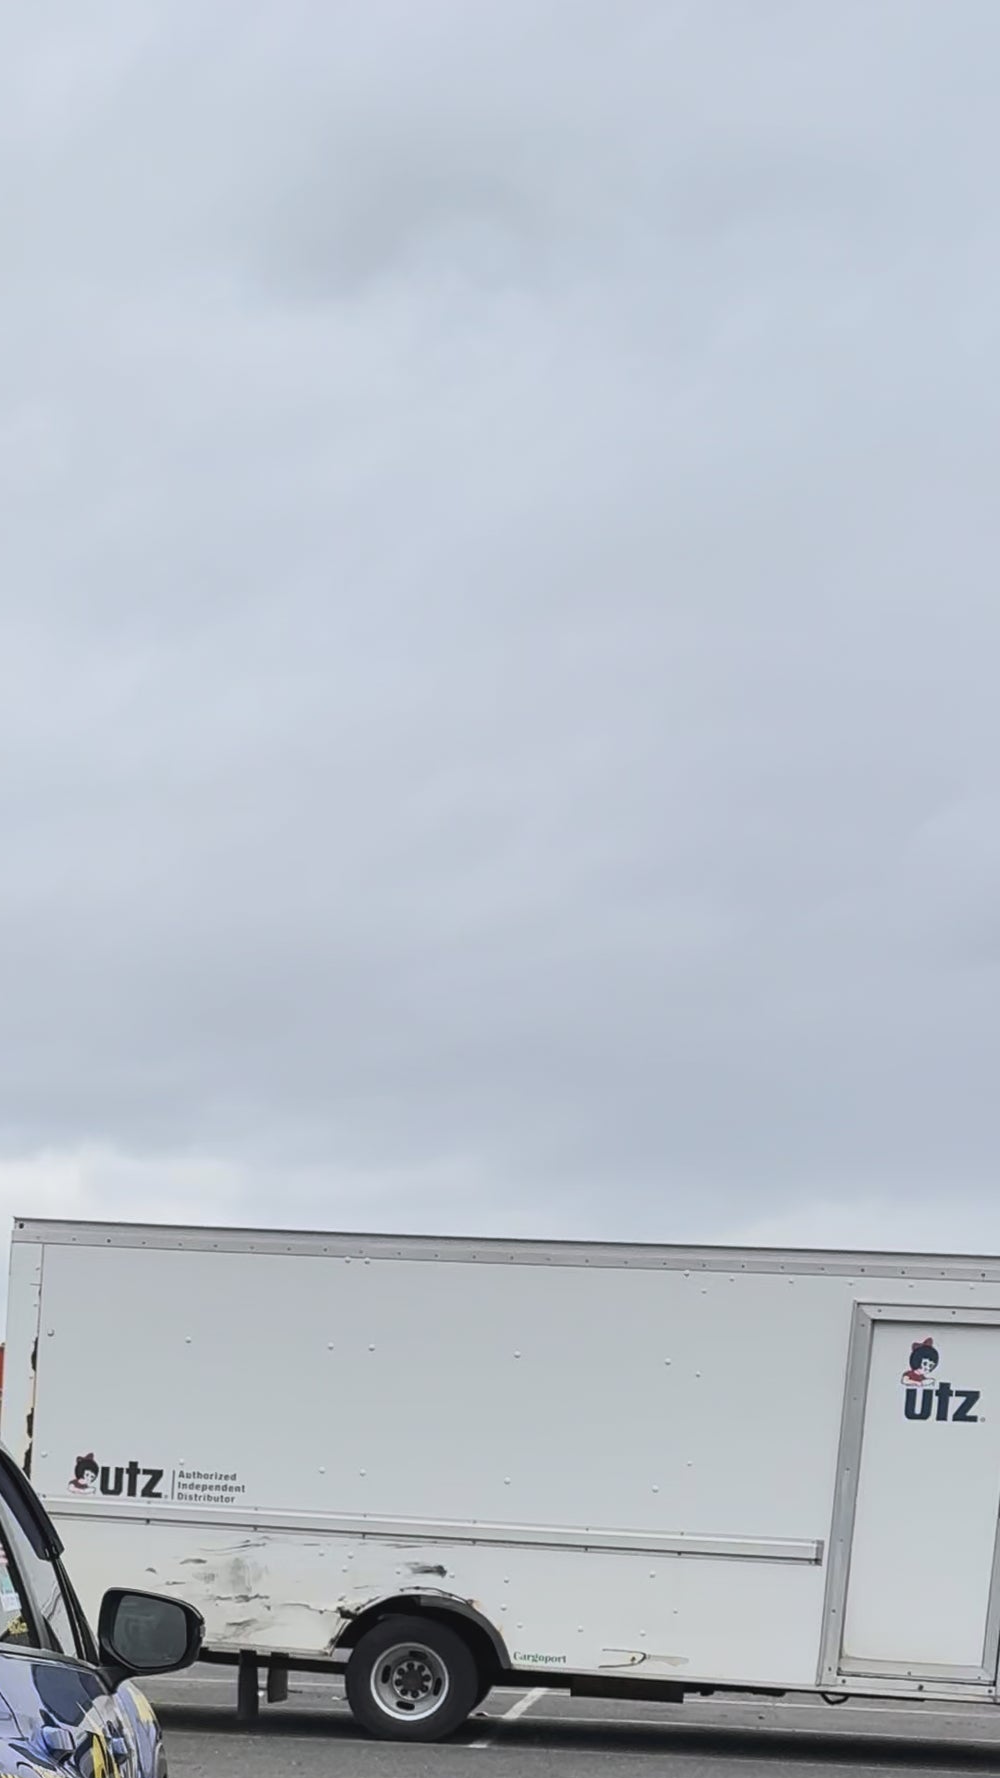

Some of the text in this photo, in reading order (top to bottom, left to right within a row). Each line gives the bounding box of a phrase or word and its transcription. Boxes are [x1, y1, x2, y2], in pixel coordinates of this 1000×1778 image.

[904, 1382, 981, 1422] utz
[100, 1461, 164, 1498] utz
[178, 1470, 237, 1481] Authorized
[177, 1481, 245, 1493] Independent
[177, 1492, 236, 1503] Distributor
[513, 1651, 567, 1664] Cargoport
